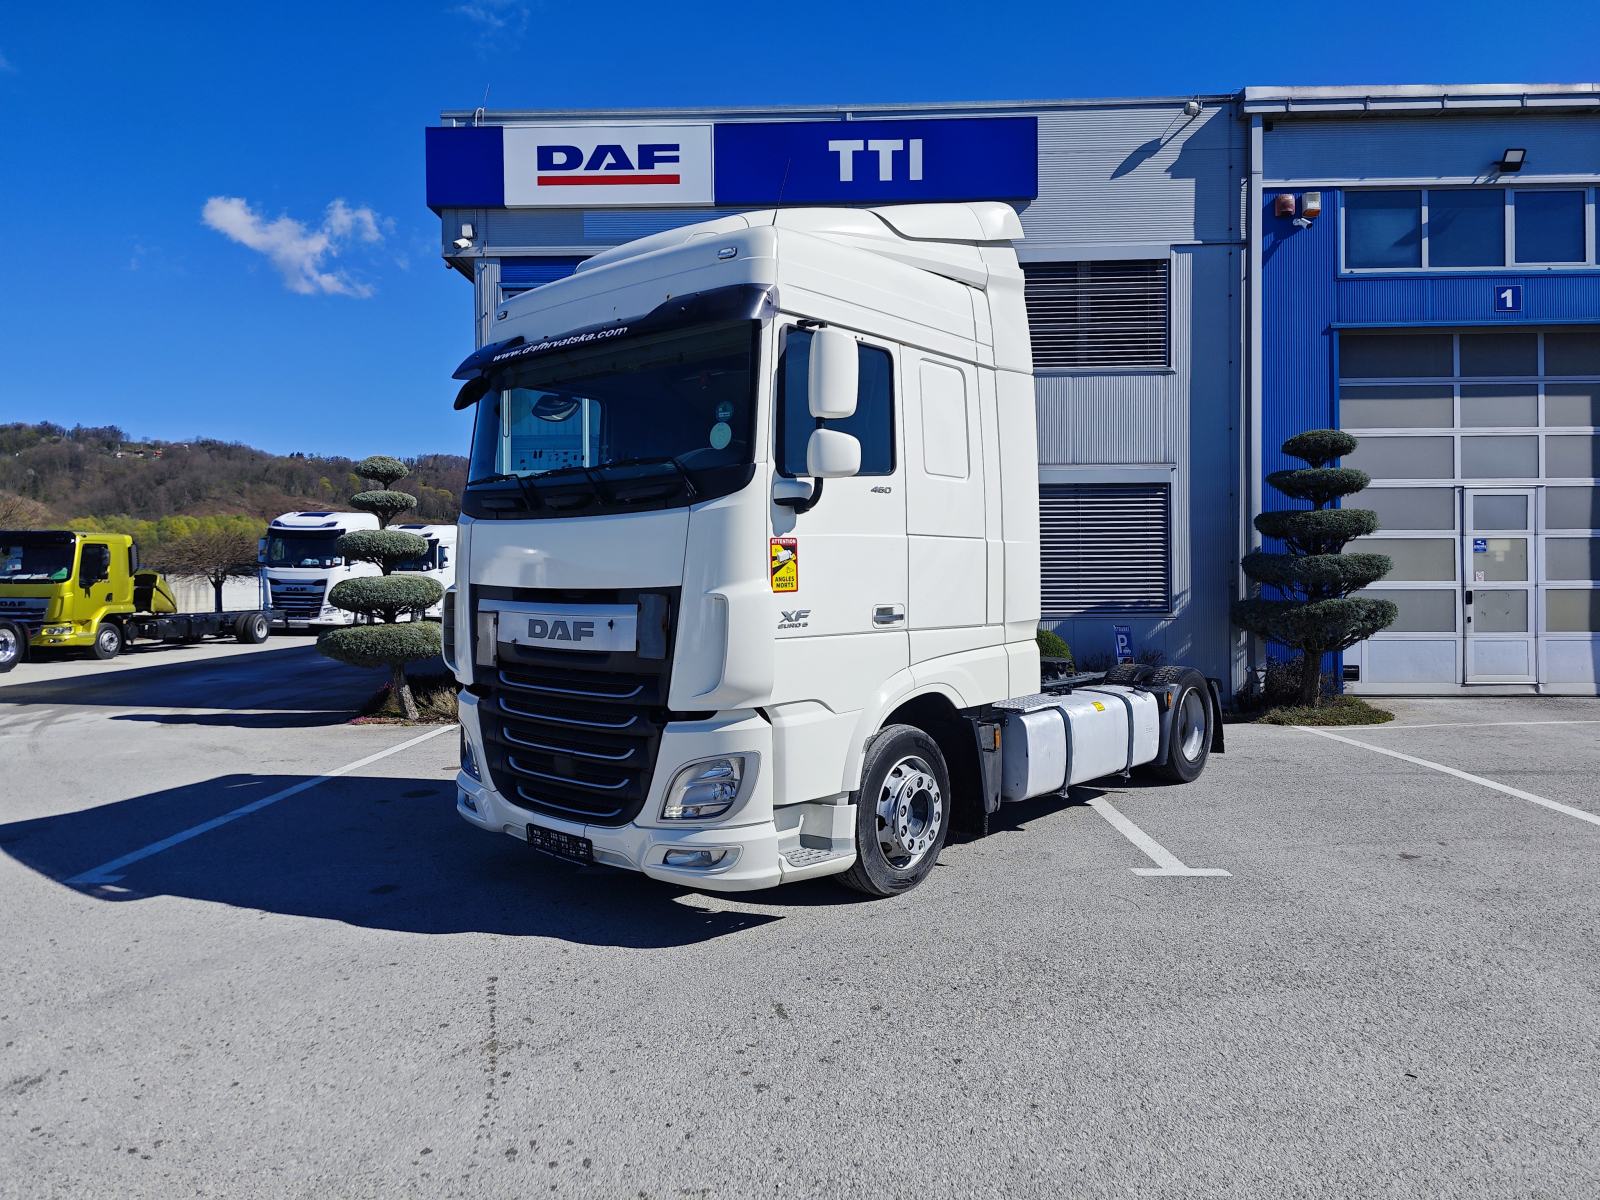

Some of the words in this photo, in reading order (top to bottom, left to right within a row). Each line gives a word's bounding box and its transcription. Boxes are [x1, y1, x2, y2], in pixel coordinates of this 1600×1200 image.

[537, 144, 680, 171] DAF
[829, 139, 923, 182] TTI
[1501, 289, 1513, 308] 1
[492, 326, 628, 362] www.dafhrvatska.com
[870, 486, 892, 494] 460
[778, 622, 801, 630] EURO
[779, 609, 811, 623] XF
[528, 618, 595, 642] DAF
[1117, 634, 1128, 654] P
